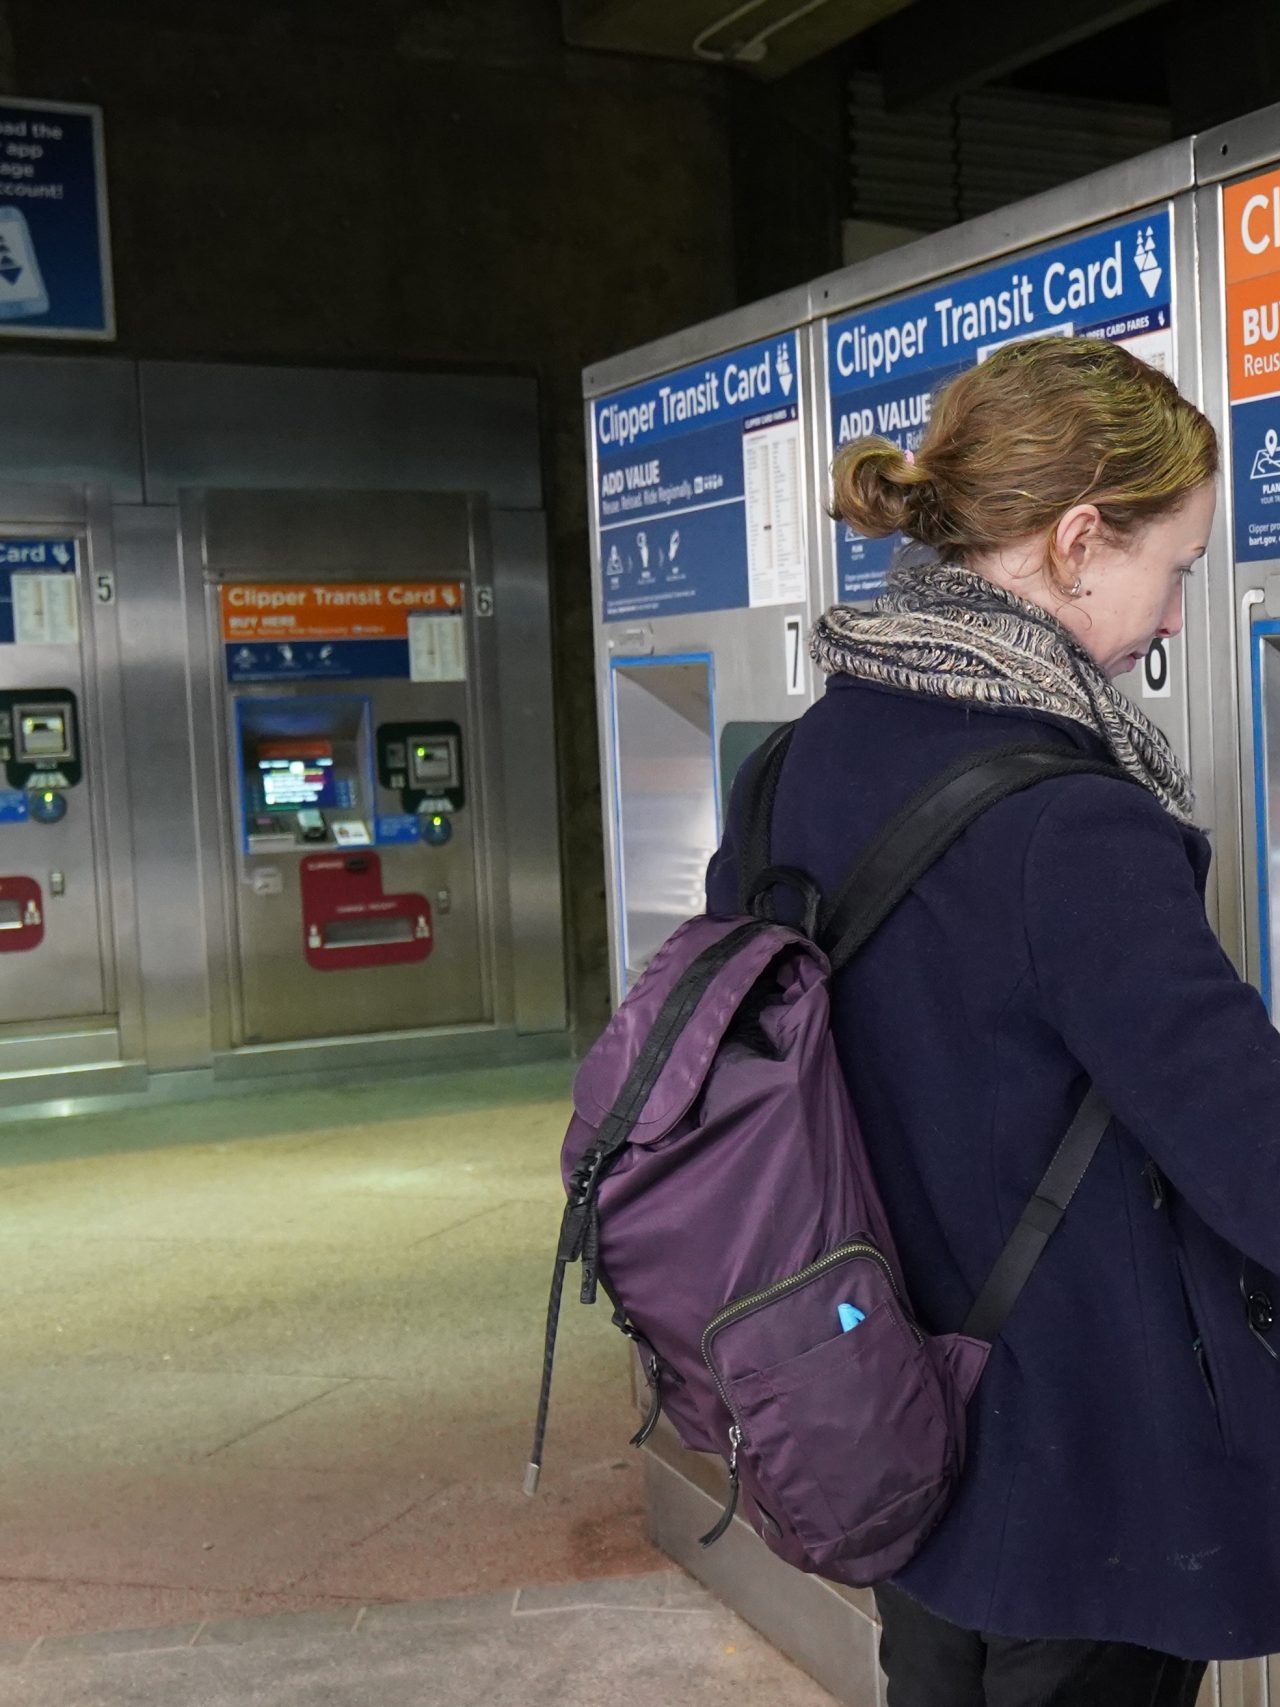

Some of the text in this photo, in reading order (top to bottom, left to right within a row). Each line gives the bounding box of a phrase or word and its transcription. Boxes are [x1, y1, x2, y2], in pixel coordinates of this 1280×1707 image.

[837, 240, 1123, 379] Clipper Transit Card
[1106, 322, 1126, 338] CARD
[1126, 315, 1150, 332] FARES
[599, 351, 771, 446] Clipper Transit Card
[838, 409, 875, 444] ADD
[877, 393, 933, 433] VALUE
[602, 460, 661, 498] ADD VALUE
[1249, 523, 1270, 535] Clipper
[97, 575, 112, 602] 5
[229, 587, 436, 609] Clipper Transit Card
[476, 590, 490, 613] 6
[787, 621, 799, 688] 7
